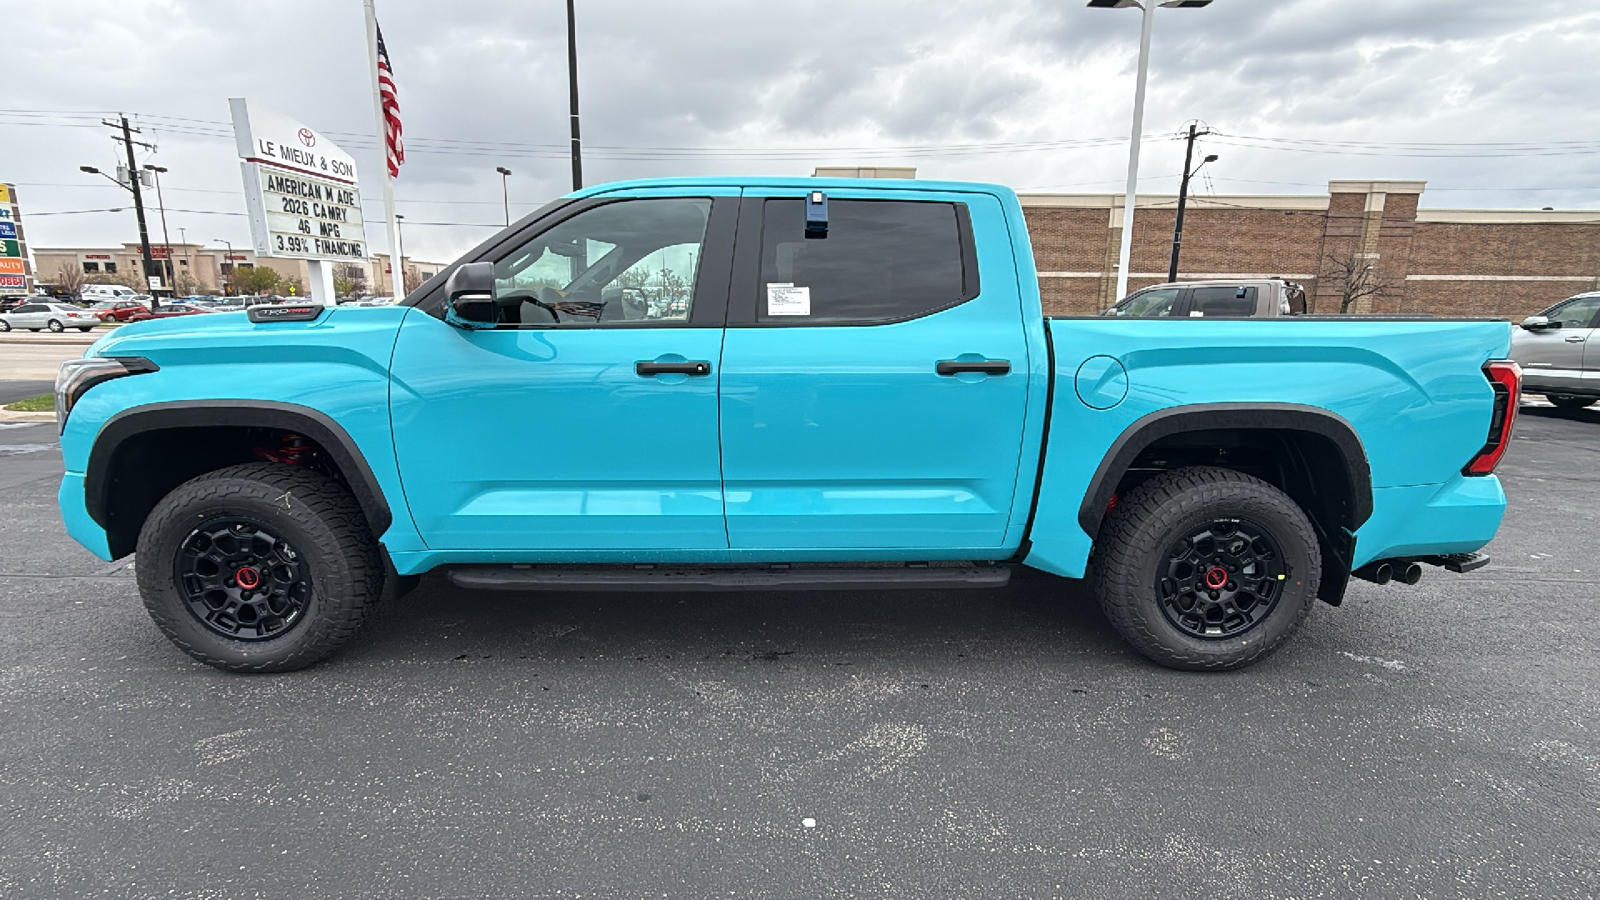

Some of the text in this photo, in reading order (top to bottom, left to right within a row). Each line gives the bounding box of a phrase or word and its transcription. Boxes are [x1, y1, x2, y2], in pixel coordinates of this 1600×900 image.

[258, 138, 354, 178] LE MIEUX & SON
[267, 174, 322, 201] AMERICAN
[281, 197, 347, 223] 2026 CAMRY
[298, 218, 341, 238] 46 MPG
[276, 235, 362, 257] 3.99% FINANCING
